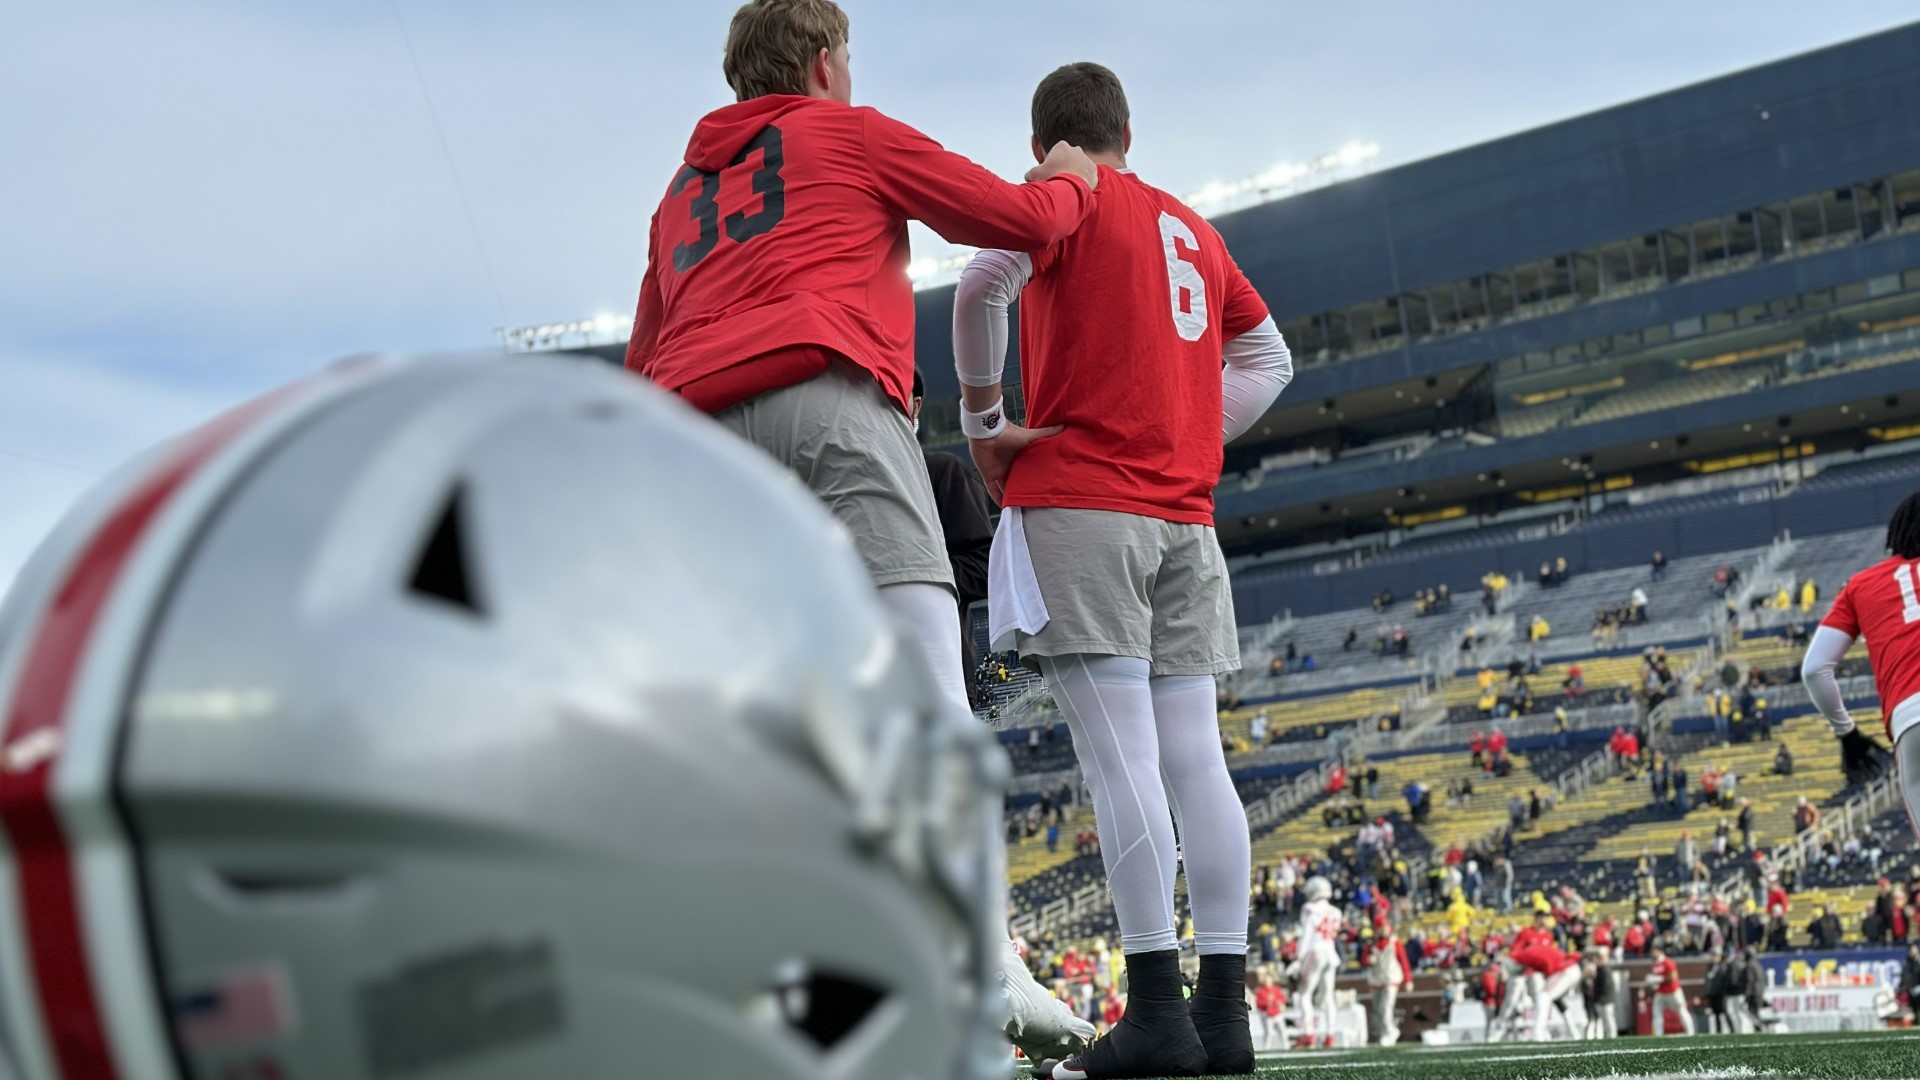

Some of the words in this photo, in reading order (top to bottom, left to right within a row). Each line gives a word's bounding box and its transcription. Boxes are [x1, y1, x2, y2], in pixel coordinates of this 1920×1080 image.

[671, 123, 786, 274] 33
[1157, 210, 1208, 342] 6
[1893, 563, 1920, 625] 1
[1804, 993, 1841, 1012] STATE
